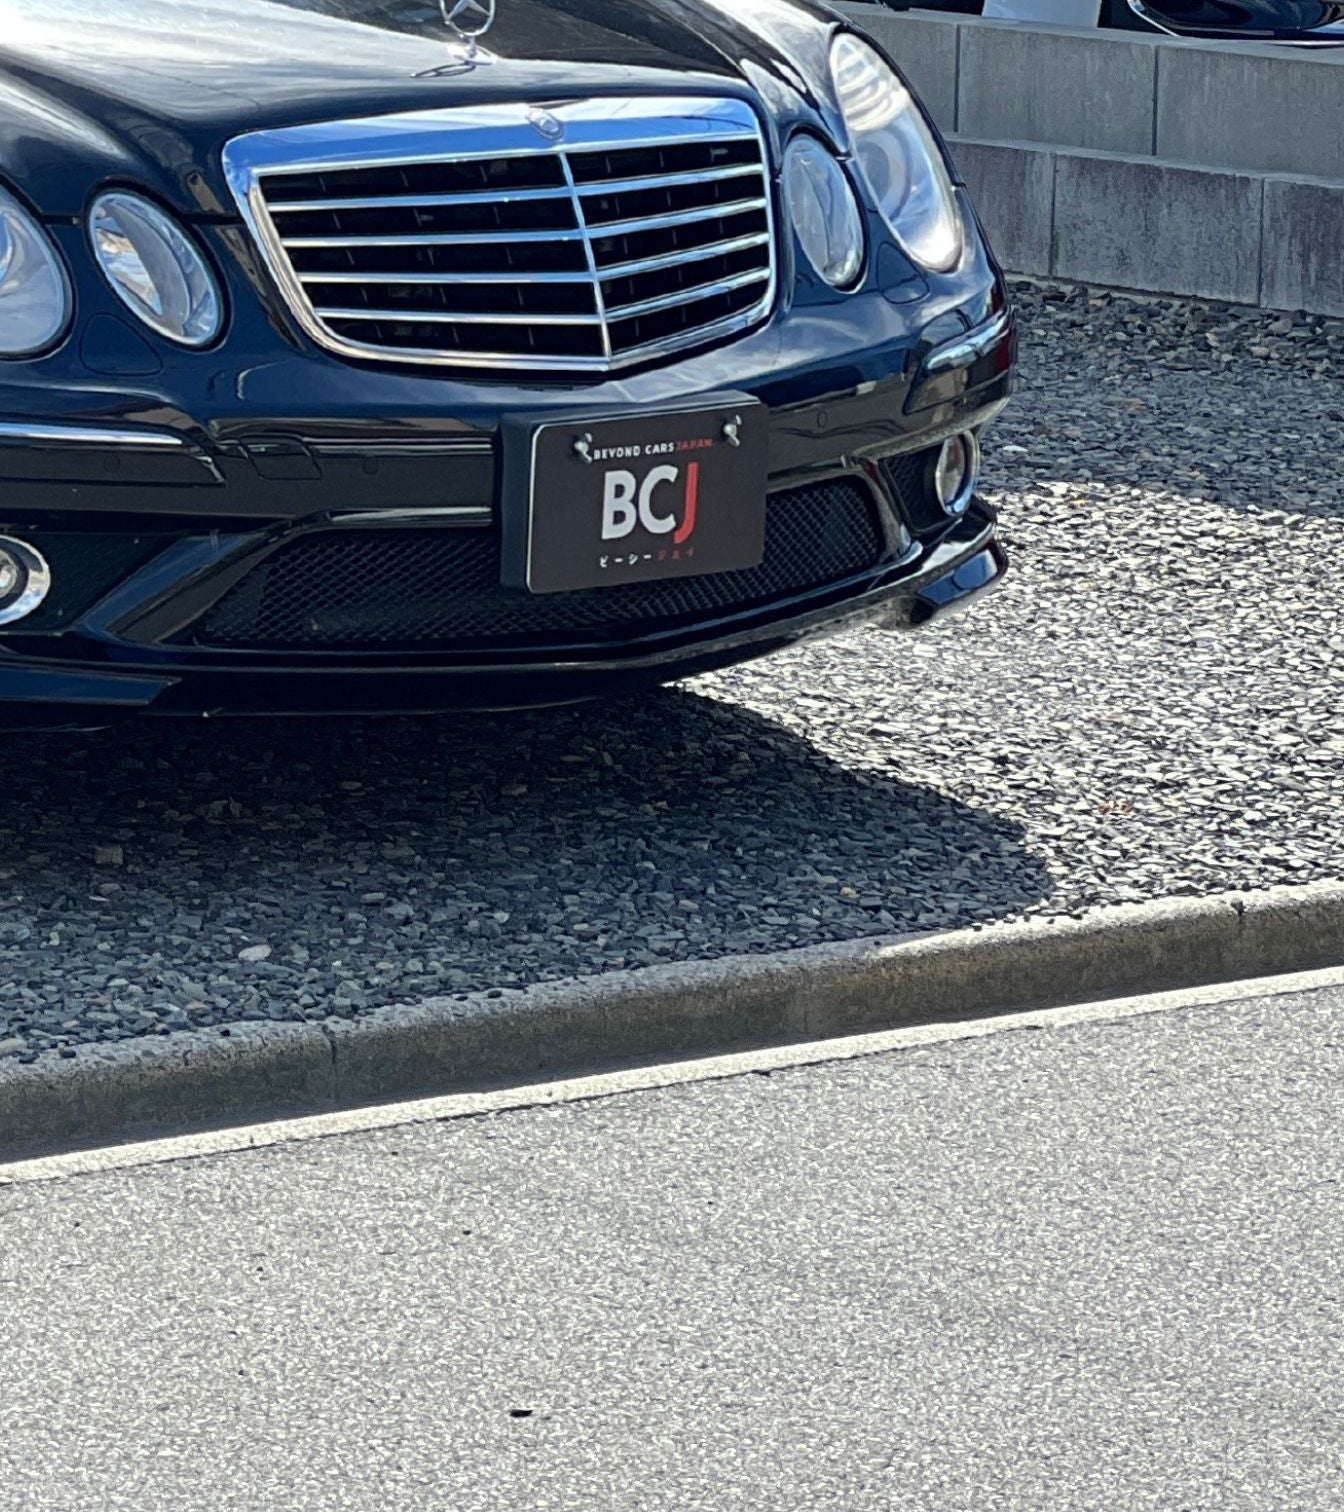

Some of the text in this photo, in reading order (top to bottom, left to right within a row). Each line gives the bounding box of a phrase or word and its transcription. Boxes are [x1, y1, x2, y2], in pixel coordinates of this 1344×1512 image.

[593, 445, 641, 461] BEYOND
[644, 442, 675, 455] CARS
[602, 462, 699, 544] BCJ
